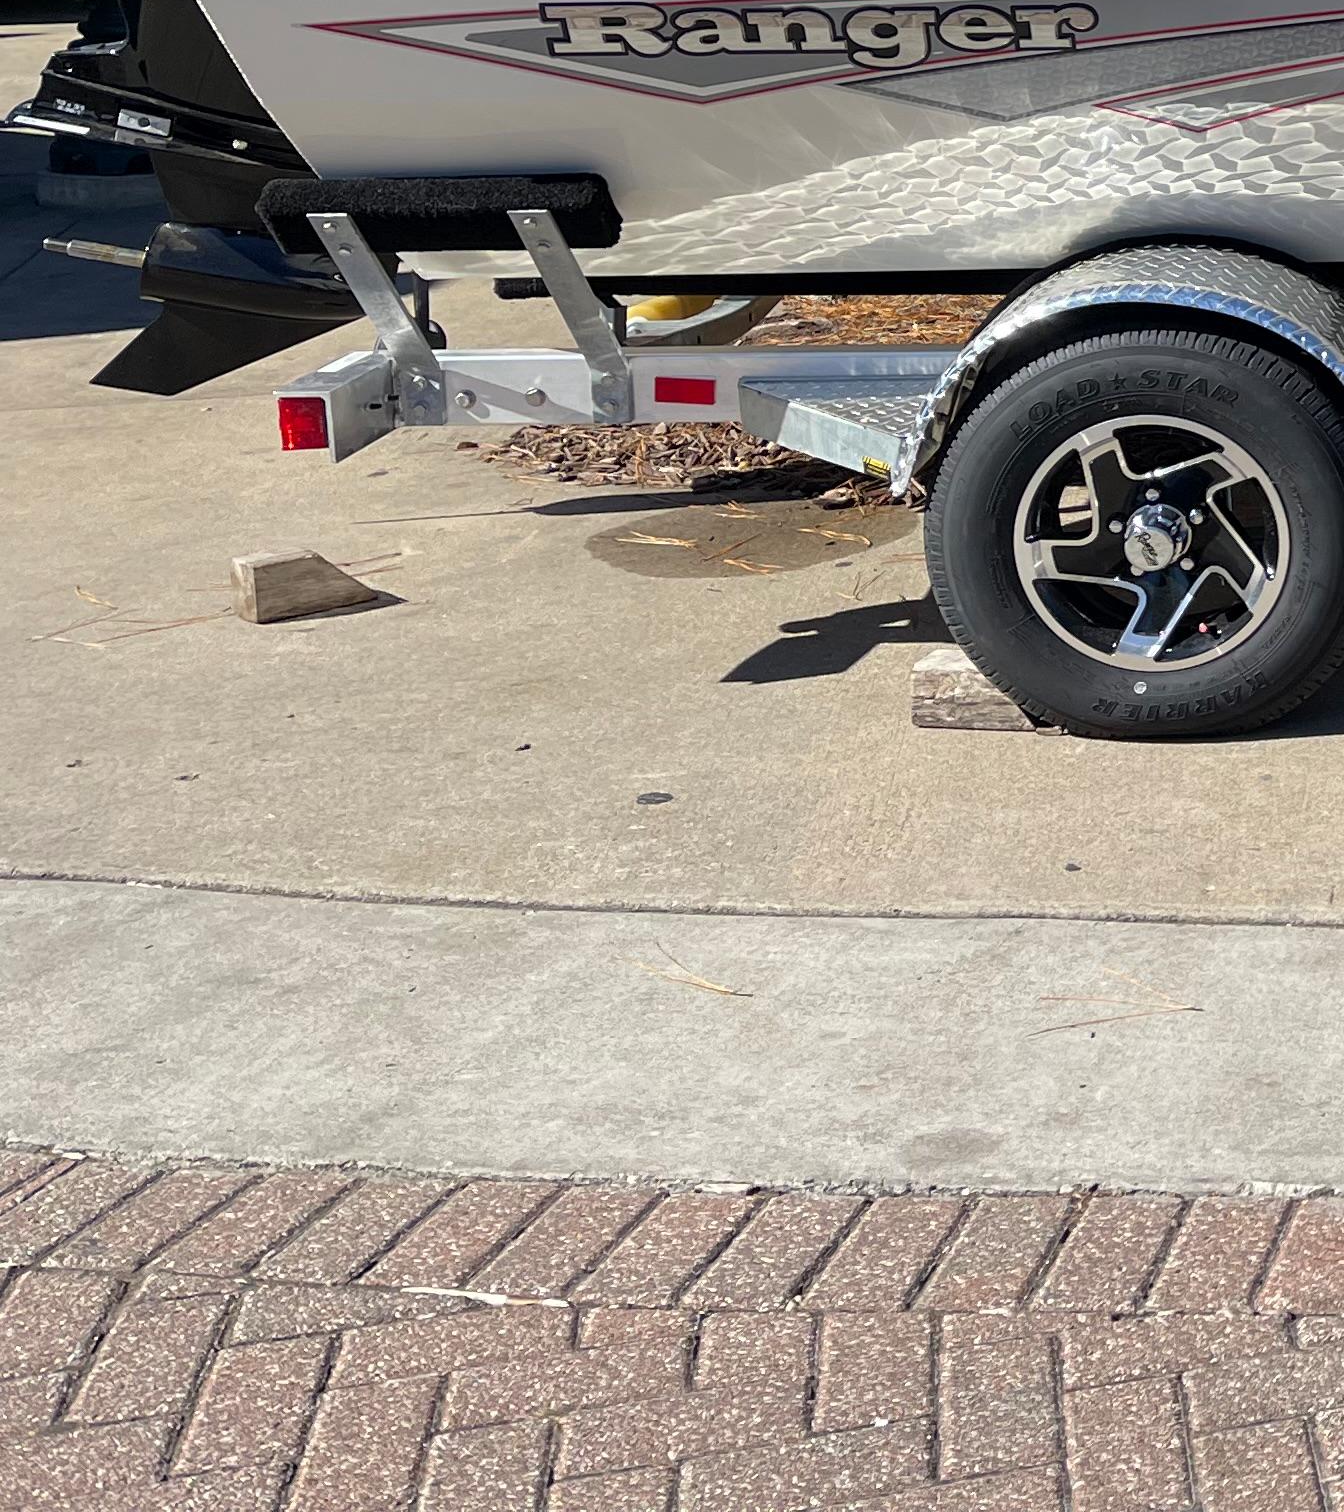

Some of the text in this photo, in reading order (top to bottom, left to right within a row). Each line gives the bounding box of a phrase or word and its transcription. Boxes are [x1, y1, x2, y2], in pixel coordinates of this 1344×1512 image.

[538, 1, 1100, 70] Ranger
[1009, 377, 1101, 442] LOAD
[1135, 368, 1241, 408] STAR
[1090, 669, 1268, 723] KARRIER
